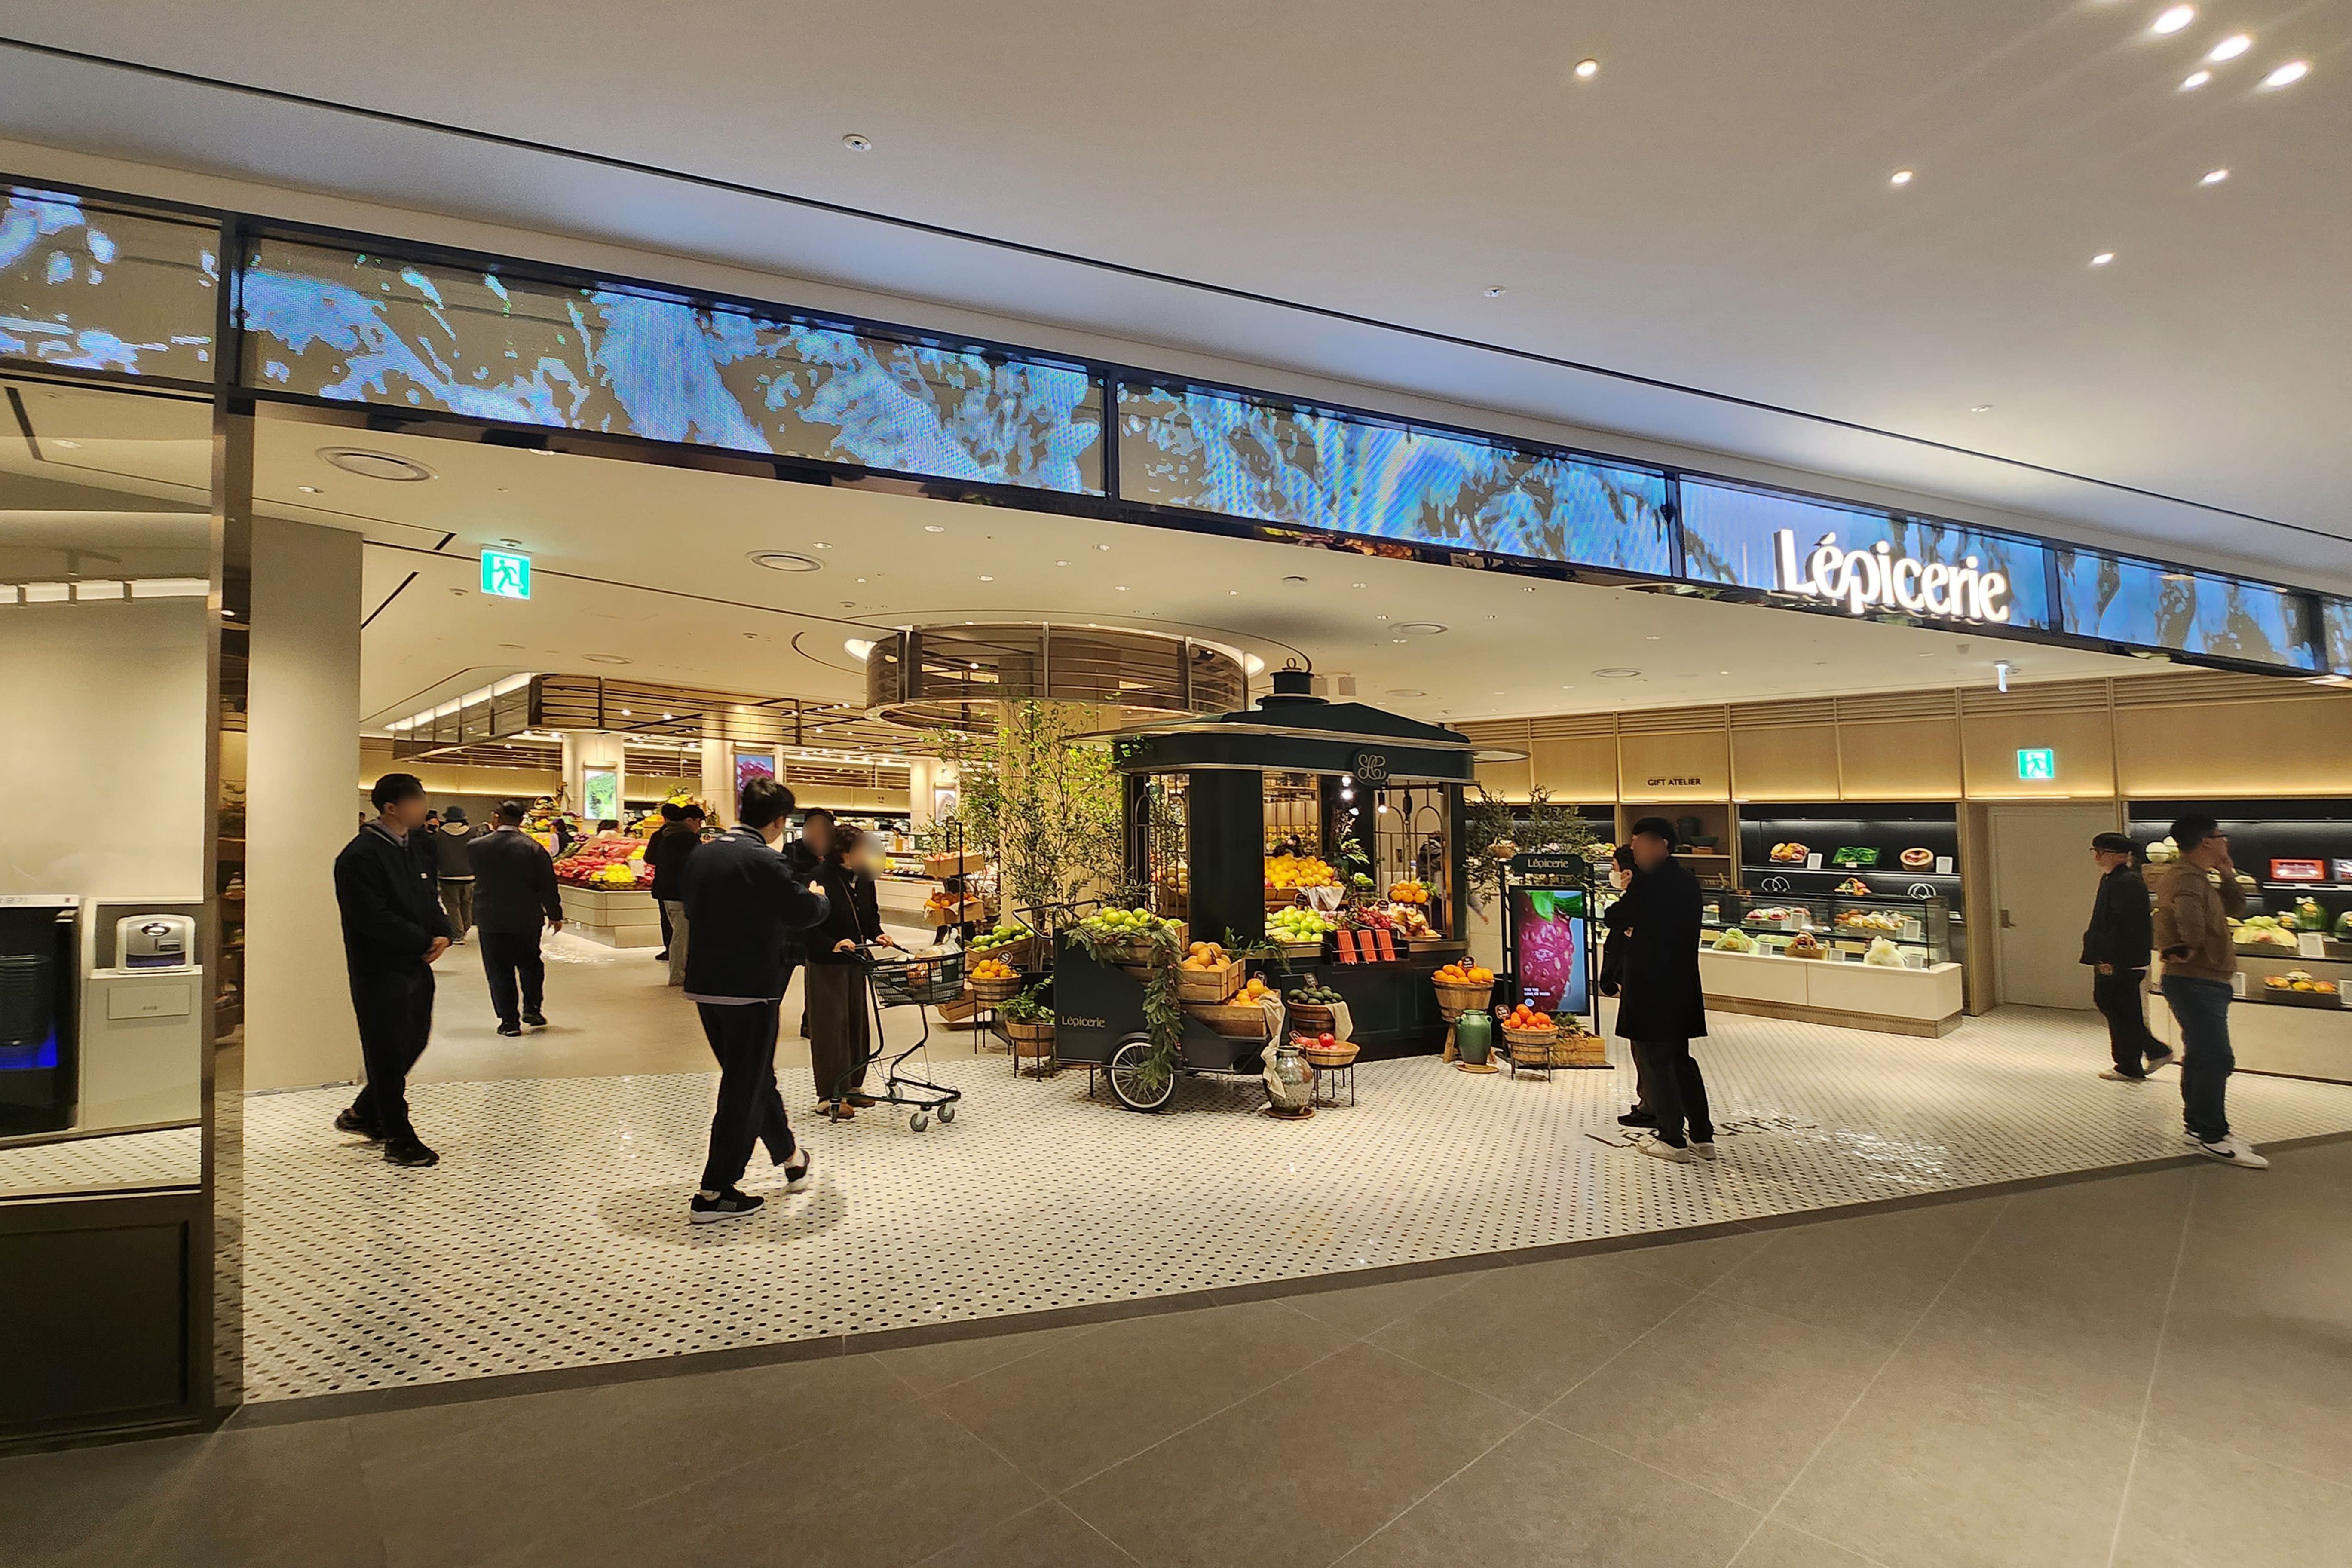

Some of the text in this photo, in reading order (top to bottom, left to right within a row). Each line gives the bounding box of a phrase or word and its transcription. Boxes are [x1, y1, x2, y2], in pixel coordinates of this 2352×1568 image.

[1779, 528, 2010, 622] Lépicerie
[1527, 858, 1569, 868] Lépicerie
[1061, 1015, 1106, 1028] Lépicerie
